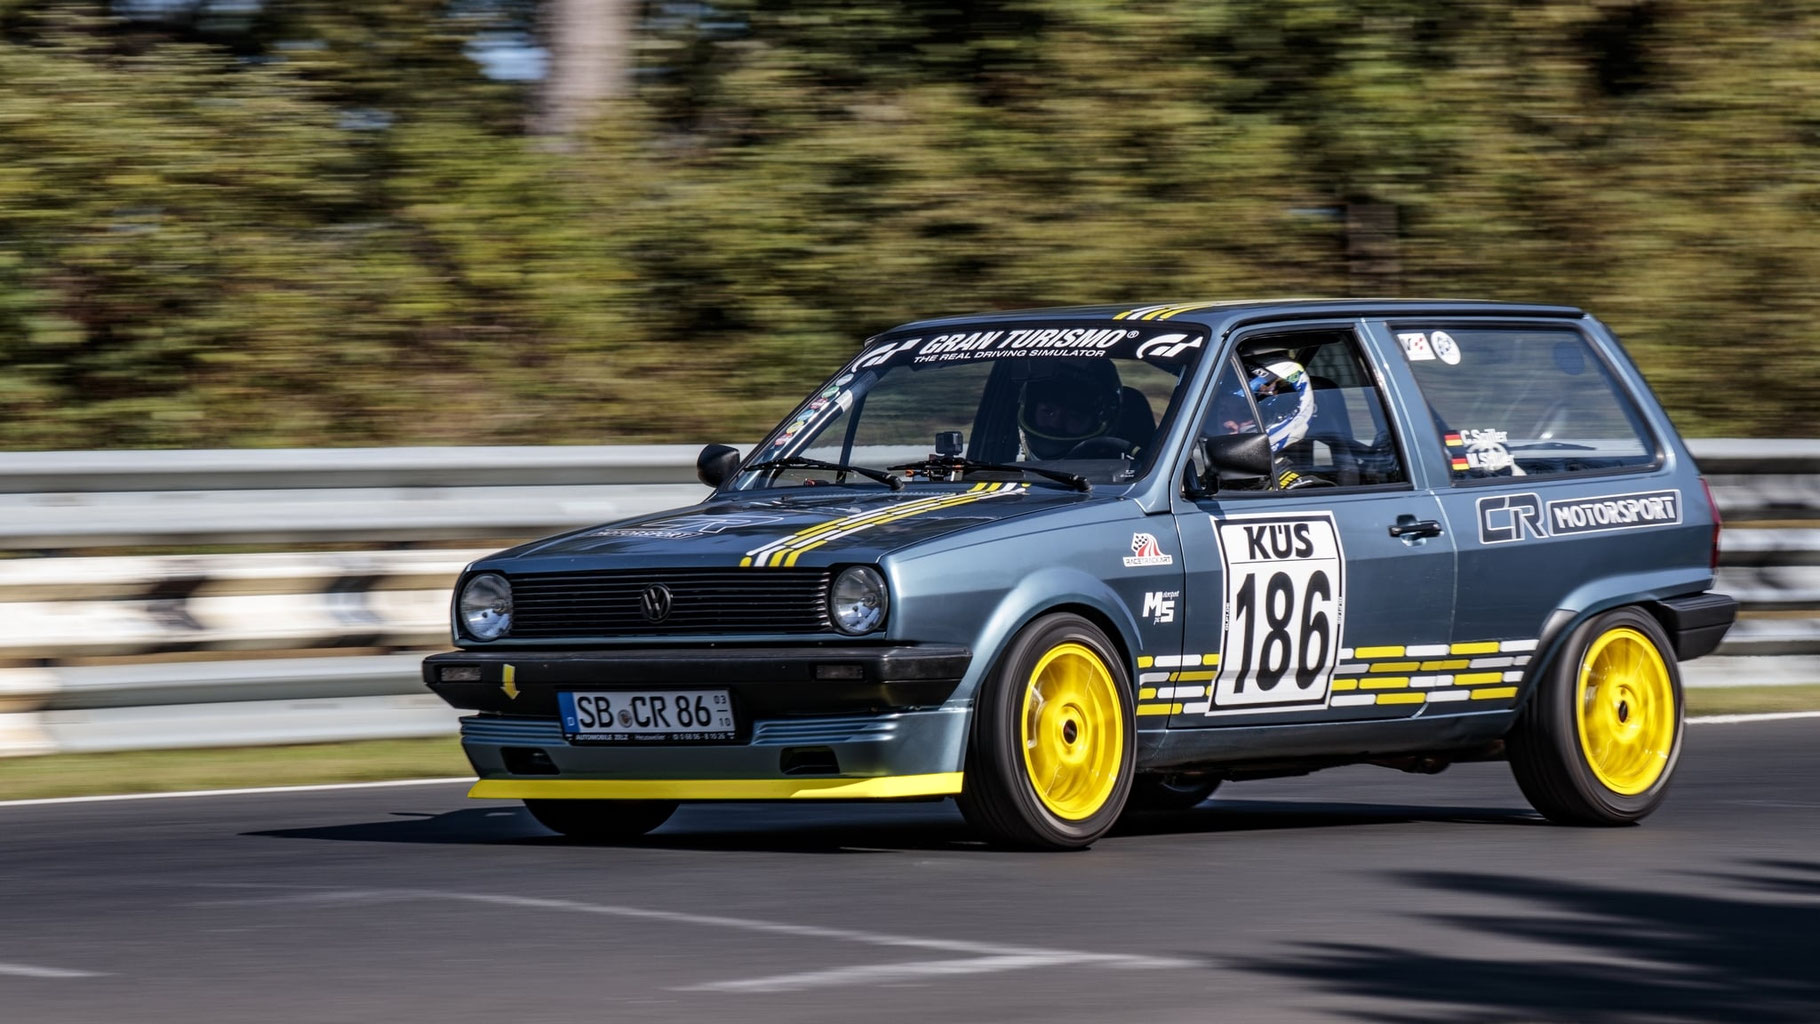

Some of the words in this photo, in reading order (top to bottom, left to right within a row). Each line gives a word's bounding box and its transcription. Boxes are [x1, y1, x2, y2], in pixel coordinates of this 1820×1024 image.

[913, 356, 938, 364] THE
[939, 353, 972, 362] REAL
[975, 350, 1027, 359] DRIVING
[1029, 349, 1106, 359] SIMULATOR
[918, 330, 1003, 355] GRAN
[1553, 496, 1676, 528] MOTORSPORT
[1243, 523, 1314, 560] KÜS
[1233, 570, 1332, 694] 186
[577, 696, 614, 728] SB
[630, 696, 671, 728] CR
[674, 695, 712, 727] 86
[719, 717, 731, 727] 10
